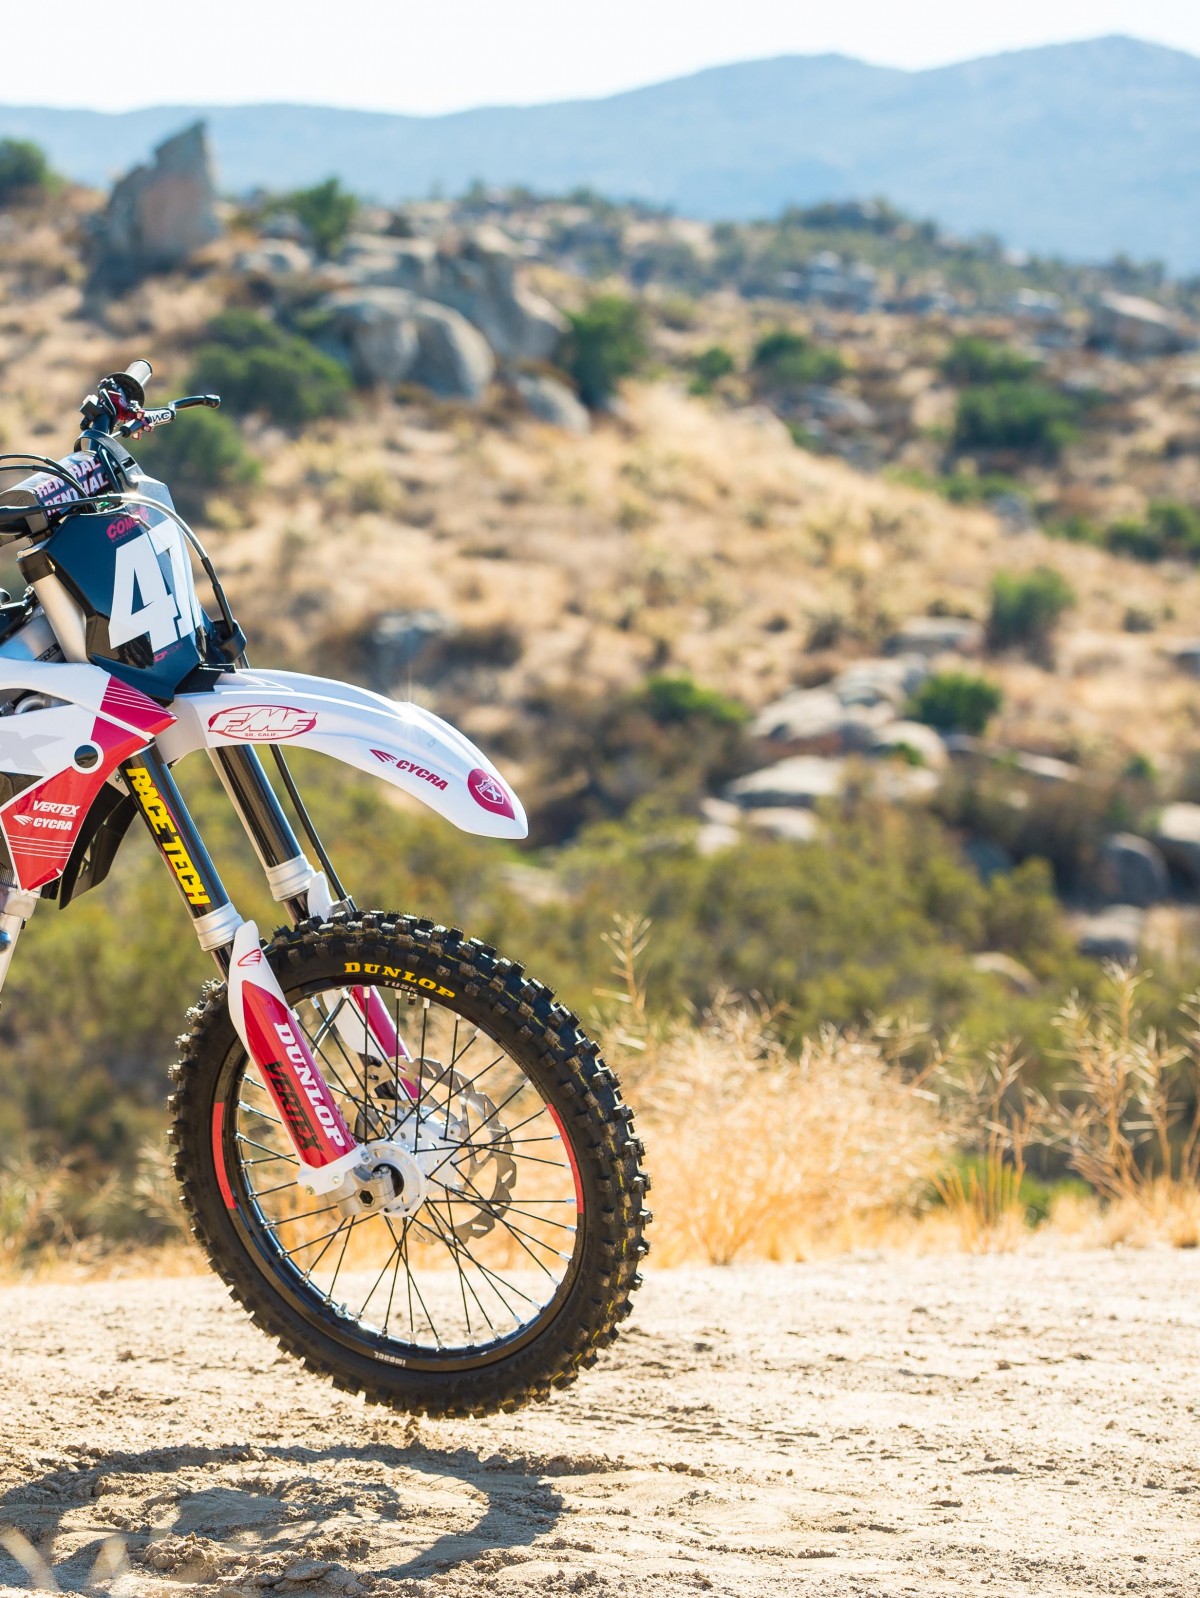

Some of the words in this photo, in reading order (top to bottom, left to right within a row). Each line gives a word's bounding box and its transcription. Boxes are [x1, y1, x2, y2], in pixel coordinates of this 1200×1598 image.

[36, 456, 102, 498] RENHAL
[208, 708, 318, 732] FMF
[396, 759, 449, 791] CYCRA
[33, 800, 81, 815] VERTEX
[33, 817, 73, 831] CYCRA
[126, 768, 177, 835] RACE
[161, 835, 211, 905] TECH
[344, 962, 456, 998] DUNLOP
[384, 980, 418, 993] TUSK
[273, 1022, 345, 1147] DUNLOP
[264, 1060, 324, 1152] VERTEX
